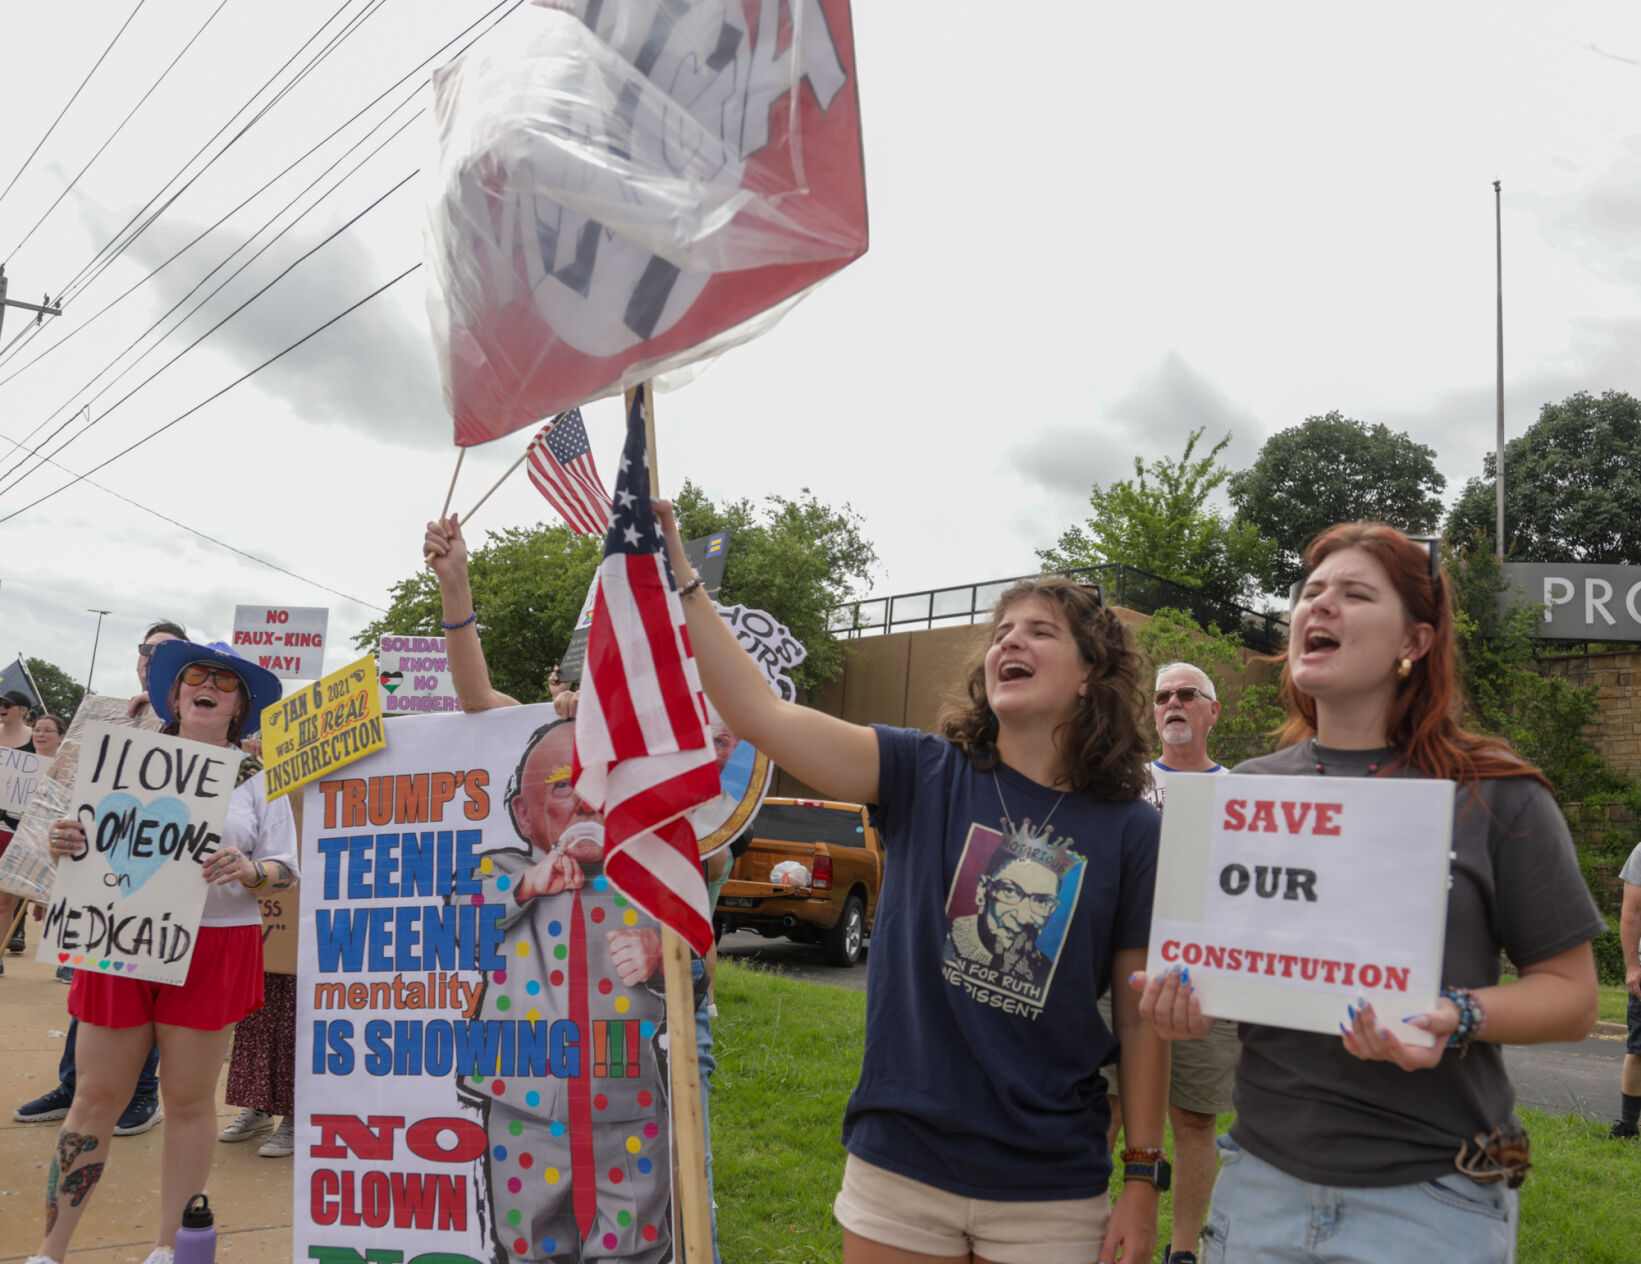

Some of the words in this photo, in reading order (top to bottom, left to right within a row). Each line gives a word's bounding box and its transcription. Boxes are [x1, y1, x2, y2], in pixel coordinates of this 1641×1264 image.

[234, 631, 322, 647] FAUX-KING
[266, 610, 289, 624] NO
[716, 606, 802, 664] HO'S
[259, 655, 301, 674] WAY!
[381, 637, 447, 653] SOLIDA
[399, 656, 452, 672] KNOW
[283, 693, 308, 733] JAN
[313, 681, 323, 709] 6
[328, 678, 350, 703] 2021
[387, 695, 463, 711] BORDERS
[414, 675, 438, 691] NO
[276, 738, 295, 758] was
[298, 714, 318, 747] HIS
[322, 692, 366, 734] REAL
[91, 734, 111, 783] I
[112, 739, 228, 798] LOVE
[266, 716, 382, 796] INSURRECTION
[10, 777, 39, 805] NP
[319, 768, 490, 829] TRUMP'S
[70, 803, 222, 865] SOMEONE
[1223, 798, 1343, 836] SAVE
[103, 872, 131, 888] on
[317, 829, 484, 900] TEENIE
[1219, 863, 1318, 902] OUR
[258, 899, 283, 917] SS
[315, 904, 507, 973] WEENIE
[969, 964, 999, 983] FOR
[1002, 975, 1041, 999] RUTH
[1160, 940, 1410, 992] CONSTITUTION
[313, 973, 484, 1018] mentality
[312, 1019, 355, 1076] IS
[364, 1018, 581, 1078] SHOWING
[592, 1019, 641, 1078] !!!
[310, 1113, 489, 1164] NO
[310, 1168, 467, 1232] CLOWN
